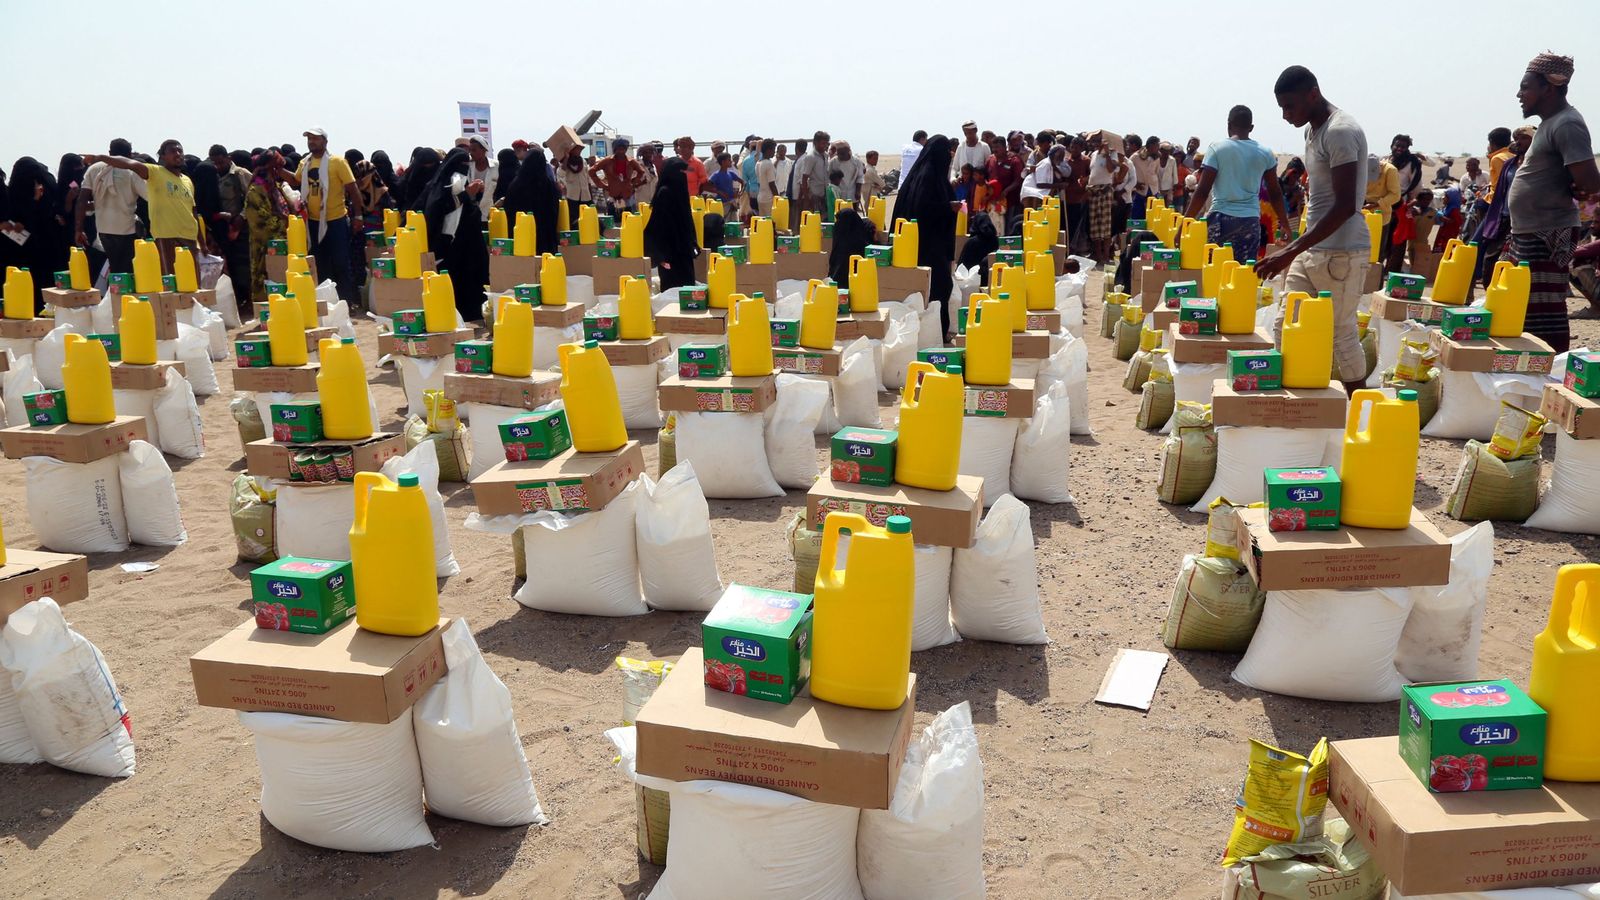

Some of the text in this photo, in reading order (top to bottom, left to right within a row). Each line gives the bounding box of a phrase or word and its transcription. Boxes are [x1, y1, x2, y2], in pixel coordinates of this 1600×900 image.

[734, 645, 760, 658] الخير
[1474, 728, 1510, 744] الخير
[716, 757, 750, 769] 24TINS
[761, 762, 785, 773] 400G
[684, 765, 820, 791] CANNED RED KIDNEY BEANS
[1506, 855, 1546, 866] 24TINS
[1559, 852, 1588, 862] 400G
[1465, 866, 1600, 885] NED RED KIDNEY BEANS
[1308, 878, 1361, 898] SILVER
